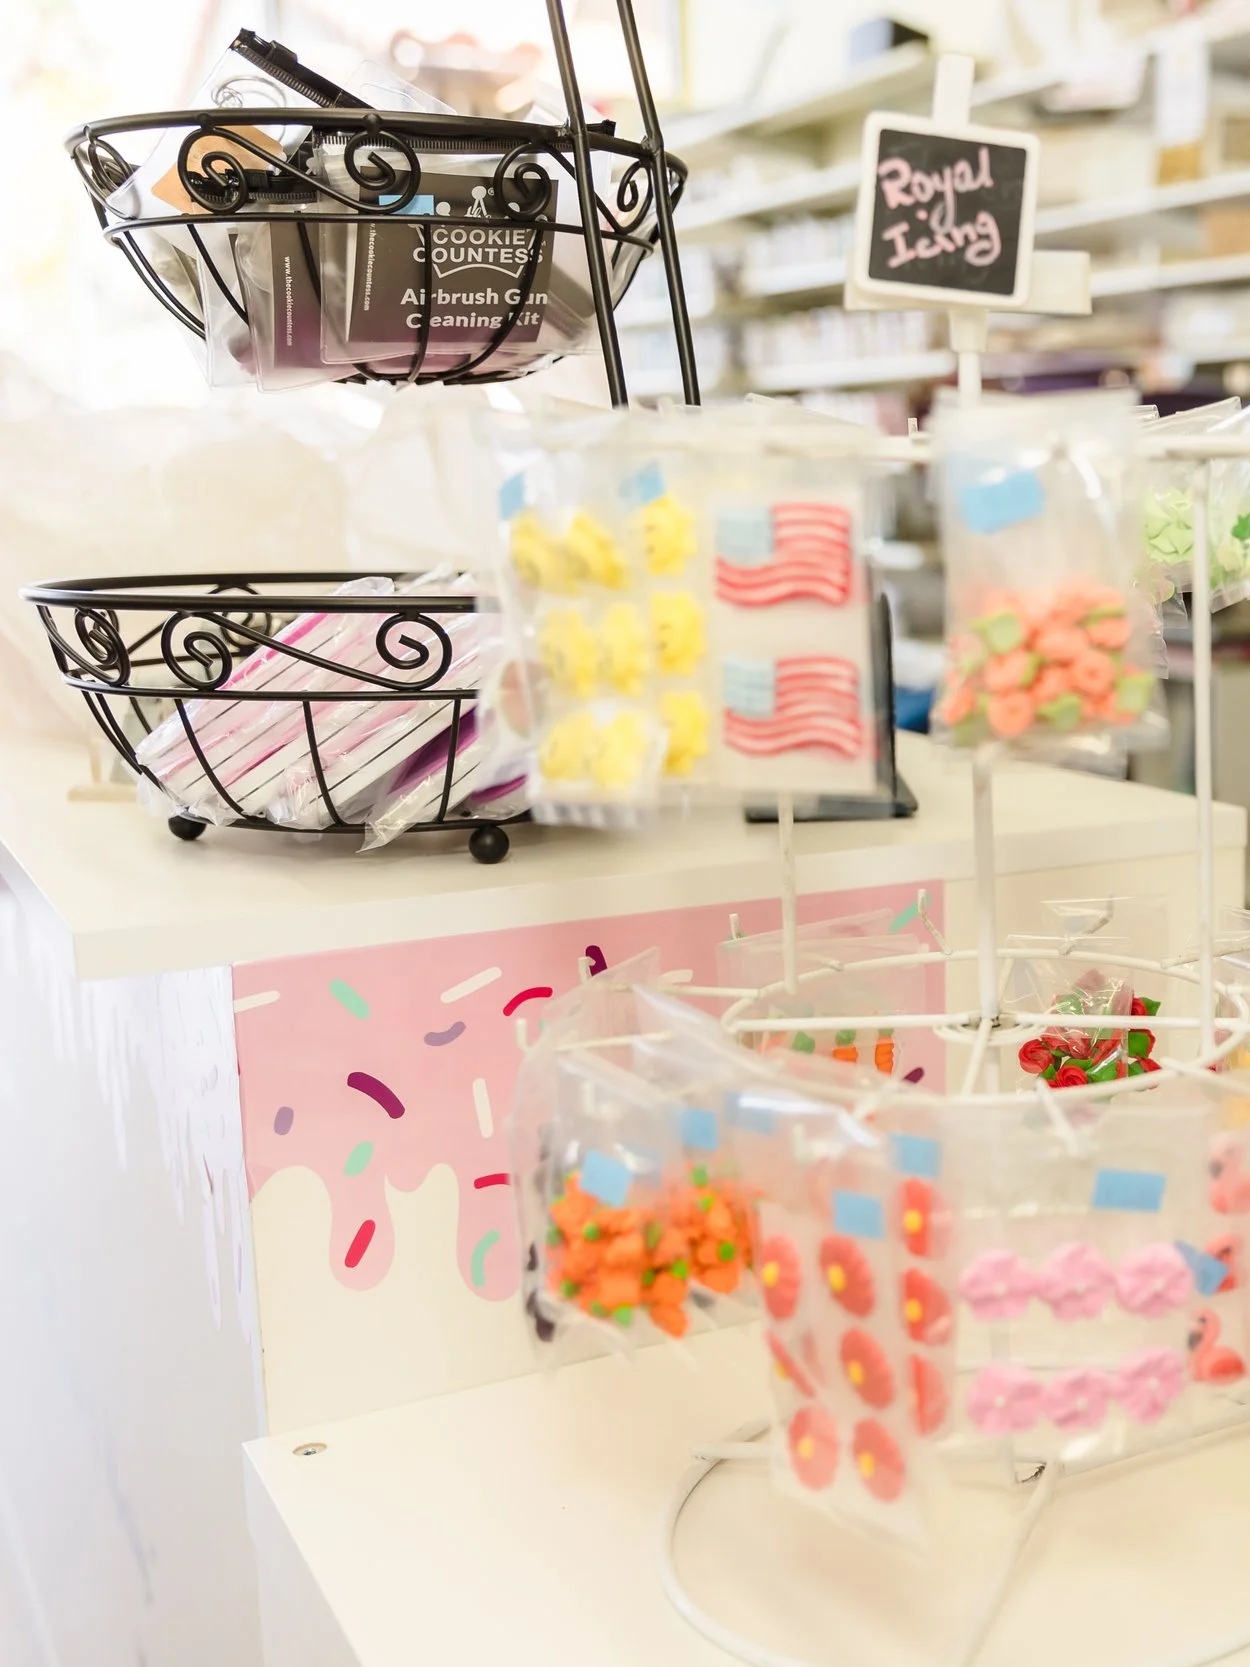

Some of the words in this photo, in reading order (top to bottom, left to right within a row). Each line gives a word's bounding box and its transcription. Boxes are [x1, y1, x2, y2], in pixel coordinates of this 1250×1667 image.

[878, 147, 994, 234] Royal
[432, 228, 526, 245] COOKIE
[881, 211, 1002, 268] Icing
[284, 256, 294, 346] www.thecookiecountess.com
[406, 311, 503, 329] Ceaning
